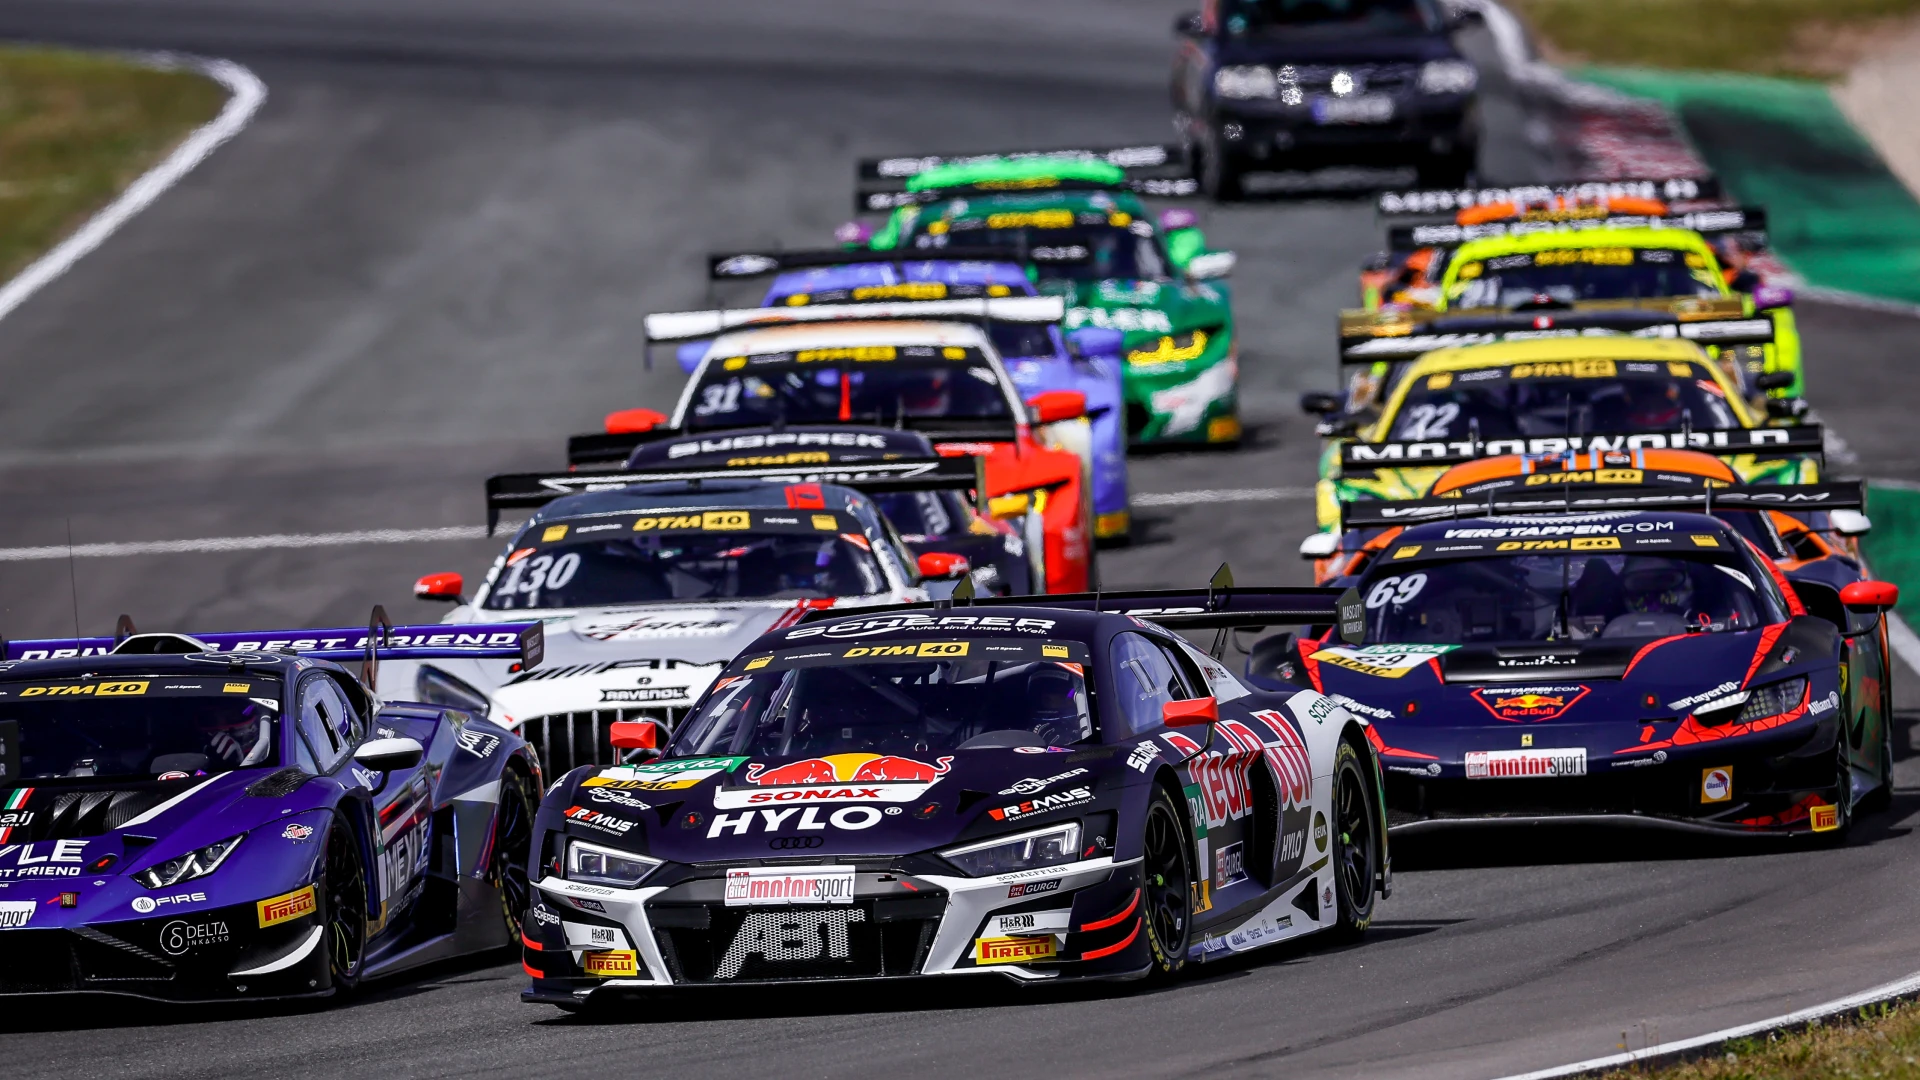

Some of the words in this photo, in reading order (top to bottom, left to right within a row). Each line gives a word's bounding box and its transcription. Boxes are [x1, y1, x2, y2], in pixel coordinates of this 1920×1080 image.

[694, 381, 742, 415] 31
[1401, 402, 1460, 439] 22
[1525, 470, 1595, 485] DTM
[633, 515, 701, 531] DTM
[1444, 521, 1674, 539] VERSTAPPEN.COM
[1496, 540, 1569, 551] DTM
[496, 553, 581, 596] 130
[1365, 572, 1428, 609] 69
[785, 614, 1056, 640] SCHERER
[905, 624, 941, 632] Autos
[1016, 626, 1047, 635] Welt.
[231, 637, 346, 651] BEST
[843, 645, 917, 658] DTM
[1326, 655, 1392, 676] ADAC
[19, 685, 96, 697] DTM
[709, 678, 753, 718] 7
[1502, 708, 1529, 716] Red
[1529, 707, 1555, 715] Bull
[1807, 699, 1834, 716] Allianz
[1489, 754, 1585, 777] motorsport
[603, 779, 678, 790] ADAC
[587, 787, 652, 811] SCHERER
[747, 788, 884, 803] SONAX
[1003, 788, 1091, 817] REMUS
[571, 807, 634, 833] REMUS
[385, 817, 428, 898] MEYLE
[17, 866, 81, 877] FRIEND
[997, 866, 1069, 882] SCHAEFFLER
[728, 885, 748, 898] Bild
[750, 876, 853, 901] motorsport
[1026, 881, 1059, 894] GURGL
[156, 892, 207, 907] FIRE
[263, 891, 314, 922] PIRELLI
[533, 904, 561, 926] SCHERER
[1000, 916, 1022, 929] H&R
[186, 921, 229, 939] DELTA
[591, 928, 607, 940] H&R
[187, 936, 229, 947] INKASSO
[713, 908, 866, 979] ABT
[982, 937, 1050, 959] PIRELLI
[586, 952, 632, 973] PIRELLI
